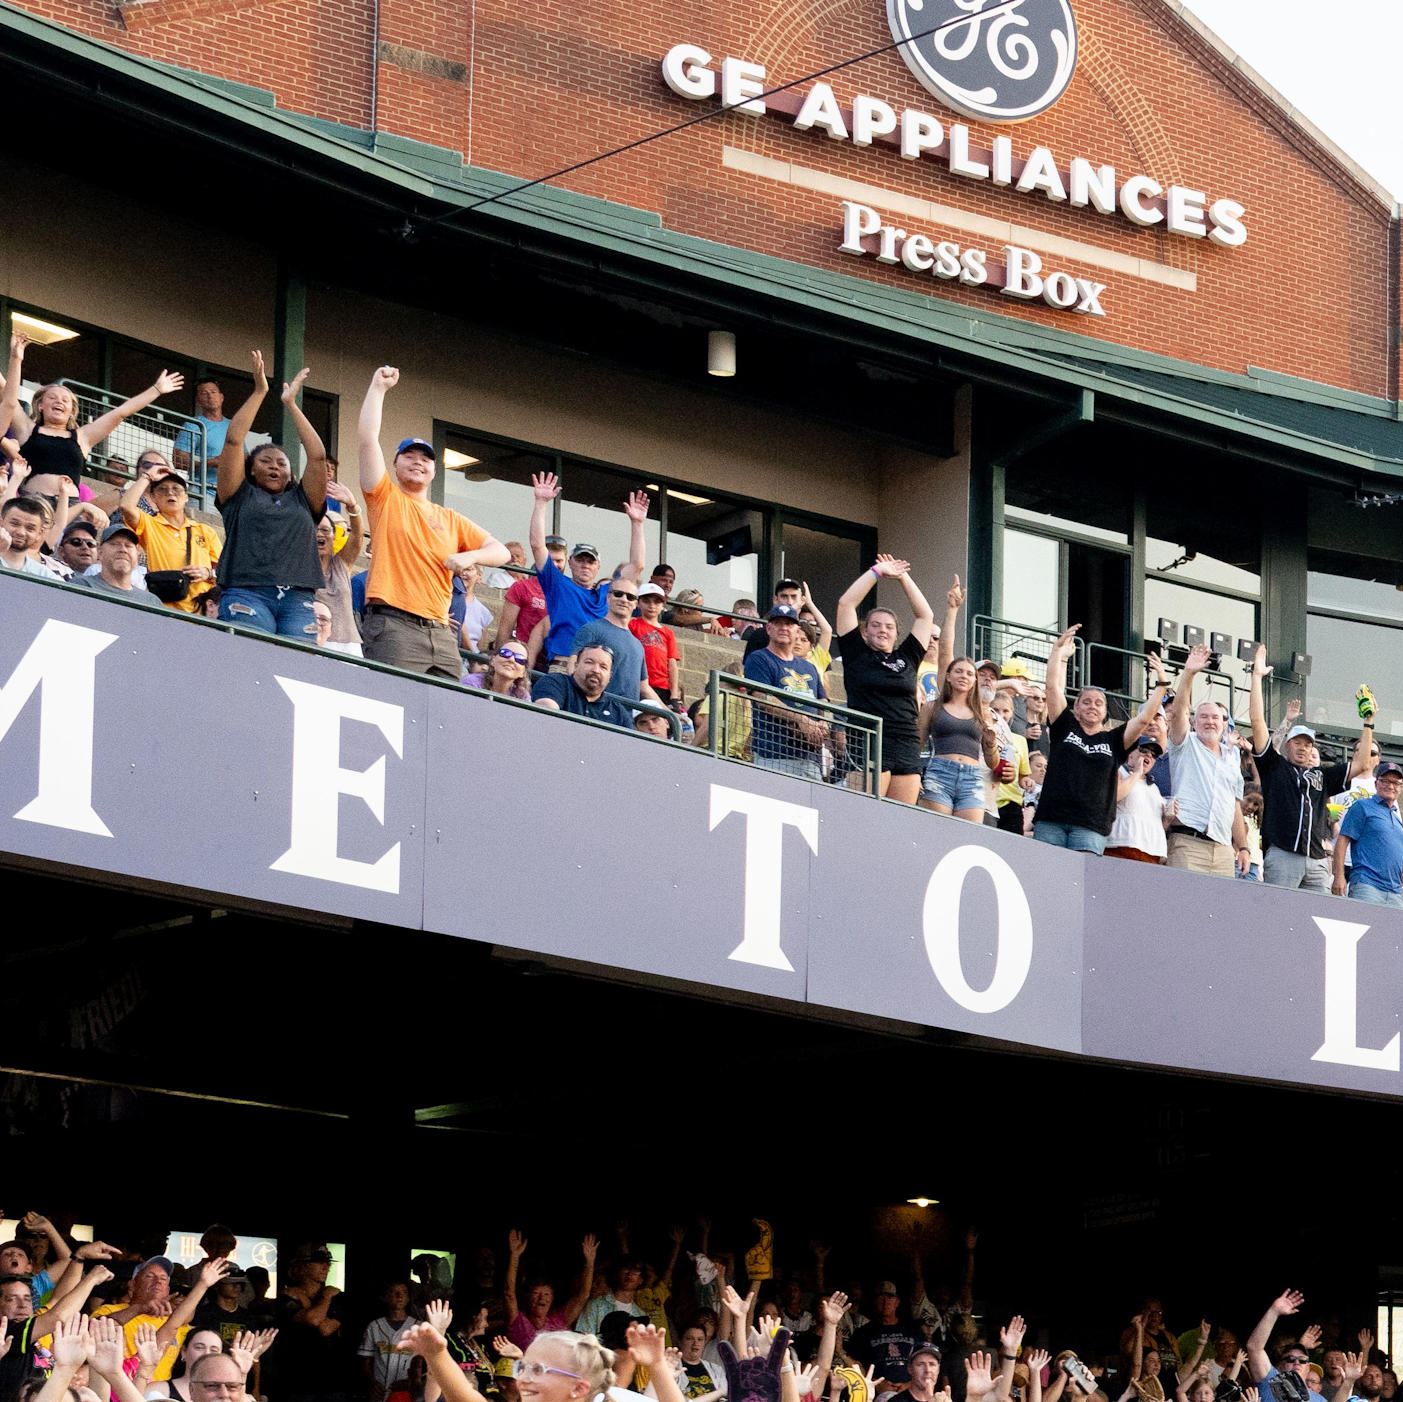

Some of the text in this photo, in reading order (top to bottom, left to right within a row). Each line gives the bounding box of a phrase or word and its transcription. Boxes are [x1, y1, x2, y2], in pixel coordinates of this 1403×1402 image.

[661, 43, 1248, 249] GE APPLIANCES
[838, 201, 1107, 317] Press Box
[709, 783, 1034, 1014] TO
